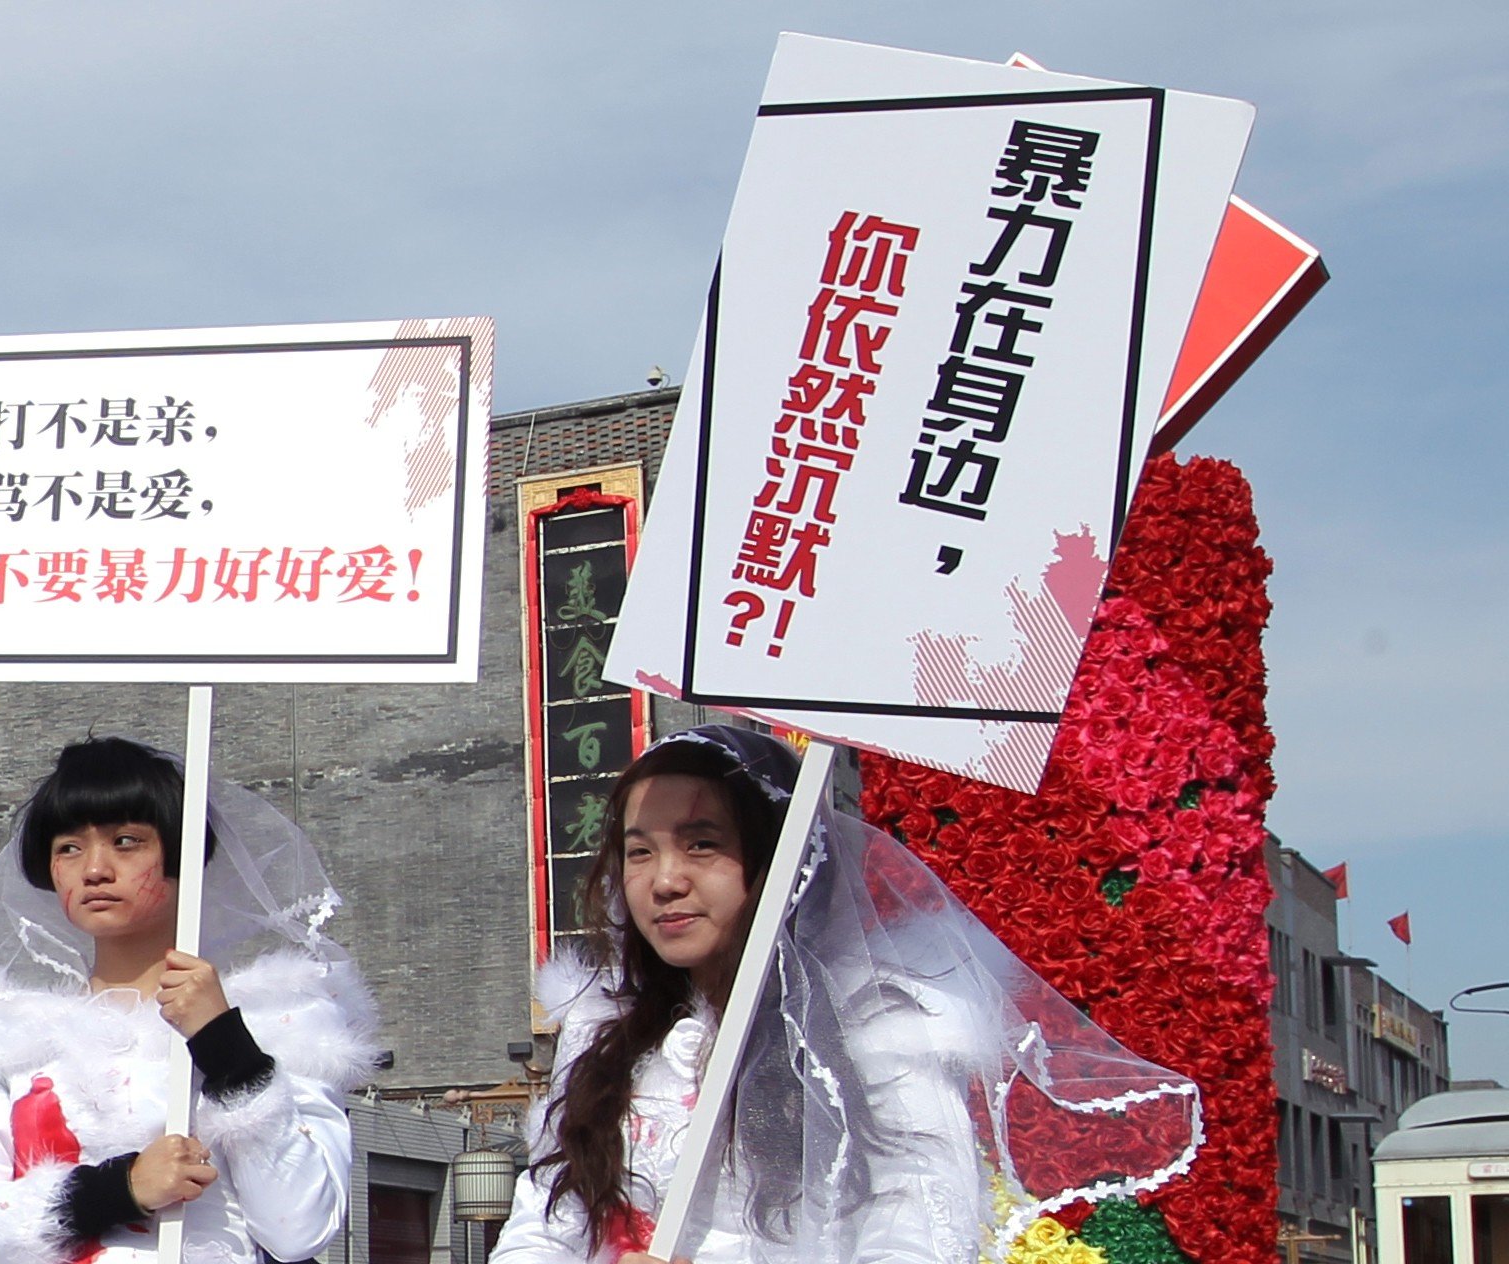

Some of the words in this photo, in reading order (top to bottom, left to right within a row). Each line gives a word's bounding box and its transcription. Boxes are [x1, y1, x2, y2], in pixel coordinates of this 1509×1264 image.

[722, 209, 921, 659] 你依然沉默?!
[898, 119, 1102, 577] 暴力在身边,
